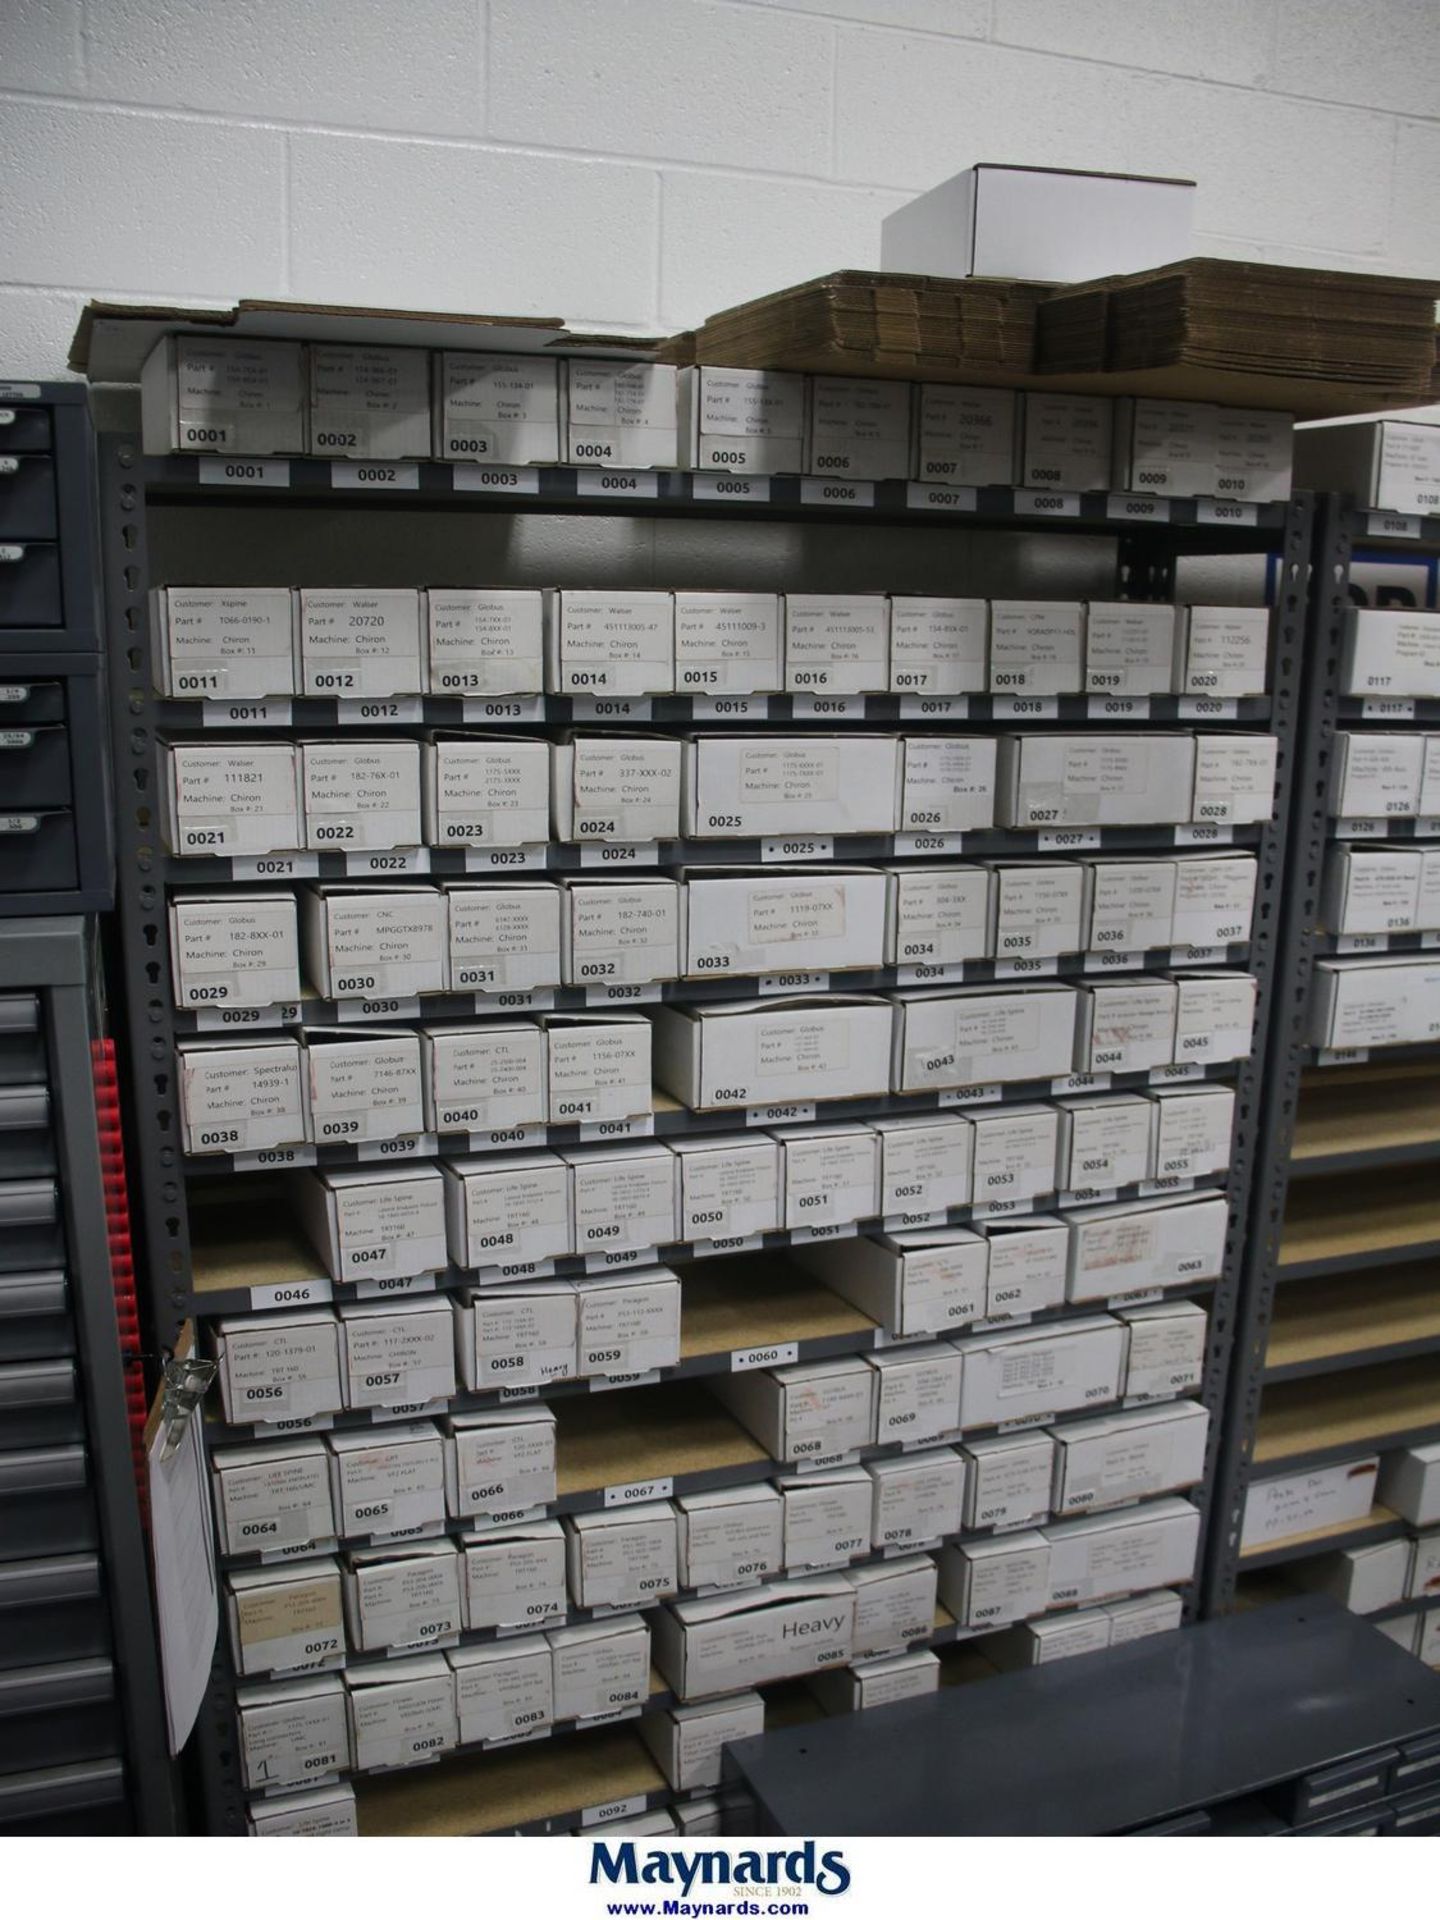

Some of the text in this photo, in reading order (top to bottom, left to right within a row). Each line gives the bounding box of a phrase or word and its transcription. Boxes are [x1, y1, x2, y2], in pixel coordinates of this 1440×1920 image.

[187, 429, 226, 442] 0001
[318, 433, 356, 446] 0002
[450, 440, 487, 452] 0003
[576, 445, 611, 457] 0004
[712, 452, 745, 464] 0005
[817, 456, 849, 468] 0006
[226, 465, 263, 478] 0001
[926, 462, 957, 474] 0007
[358, 469, 396, 481] 0002
[481, 473, 517, 485] 0003
[602, 478, 637, 489] 0004
[717, 482, 750, 494] 0005
[823, 487, 855, 499] 0006
[309, 617, 328, 625] Part
[349, 616, 384, 626] 20720
[222, 636, 249, 644] Chiron
[356, 635, 385, 643] Chiron
[481, 637, 510, 645] Chiron
[179, 676, 217, 689] 0011
[315, 675, 353, 687] 0012
[442, 675, 478, 686] 0013
[572, 674, 606, 684] 0014
[684, 671, 717, 682] 0015
[795, 673, 827, 684] 0016
[896, 675, 927, 685] 0017
[996, 675, 1024, 685] 0018
[1092, 675, 1119, 686] 0019
[1191, 676, 1217, 686] 0020
[230, 707, 267, 719] 0011
[361, 705, 398, 717] 0012
[485, 704, 521, 716] 0013
[596, 703, 630, 714] 0014
[716, 702, 747, 712] 0015
[183, 776, 200, 784] Part
[225, 774, 262, 783] 111821
[311, 774, 329, 782] Part
[230, 794, 261, 802] Chiron
[357, 789, 386, 797] Chiron
[1030, 810, 1058, 821] 0027
[1200, 806, 1227, 816] 0028
[709, 816, 742, 827] 0025
[910, 813, 940, 823] 0026
[316, 827, 353, 839] 0022
[447, 825, 483, 837] 0023
[580, 822, 615, 833] 0024
[187, 832, 225, 844] 0021
[602, 849, 635, 860] 0024
[783, 843, 815, 854] 0025
[370, 857, 406, 869] 0022
[491, 853, 525, 864] 0023
[257, 861, 293, 873] 0021
[185, 934, 203, 943] Part
[1004, 937, 1031, 947] 0035
[1098, 931, 1124, 941] 0036
[379, 942, 408, 950] Chiron
[904, 945, 933, 954] 0034
[233, 949, 263, 957] Chiron
[697, 957, 729, 968] 0033
[581, 964, 615, 975] 0032
[460, 971, 494, 983] 0031
[779, 975, 809, 986] 0033
[338, 978, 374, 990] 0030
[190, 987, 228, 1000] 0029
[608, 987, 640, 998] 0032
[499, 995, 532, 1006] 0031
[363, 1002, 398, 1014] 0030
[223, 1011, 260, 1022] 0029
[926, 1055, 955, 1070] 0043
[1096, 1053, 1122, 1064] 0044
[715, 1089, 746, 1099] 0042
[559, 1103, 592, 1114] 0041
[767, 1107, 797, 1118] 0042
[443, 1110, 478, 1123] 0040
[323, 1122, 358, 1134] 0039
[600, 1124, 630, 1134] 0041
[201, 1131, 238, 1144] 0038
[491, 1131, 524, 1143] 0040
[380, 1141, 415, 1153] 0039
[258, 1151, 294, 1163] 0038
[987, 1174, 1014, 1185] 0053
[895, 1185, 922, 1197] 0052
[800, 1195, 827, 1207] 0051
[692, 1211, 722, 1224] 0050
[587, 1226, 620, 1238] 0049
[481, 1234, 513, 1248] 0048
[352, 1250, 386, 1263] 0047
[606, 1251, 637, 1264] 0049
[502, 1263, 535, 1275] 0048
[379, 1278, 412, 1290] 0047
[274, 1289, 309, 1301] 0046
[948, 1304, 974, 1316] 0061
[491, 1357, 524, 1369] 0058
[589, 1351, 621, 1363] 0059
[748, 1351, 778, 1363] 0060
[366, 1373, 400, 1386] 0057
[247, 1387, 283, 1399] 0056
[793, 1441, 821, 1454] 0068
[472, 1484, 504, 1500] 0066
[624, 1486, 654, 1498] 0067
[355, 1504, 388, 1518] 0065
[242, 1523, 277, 1535] 0064
[835, 1539, 863, 1551] 0077
[738, 1562, 767, 1574] 0076
[640, 1579, 669, 1590] 0075
[527, 1603, 558, 1614] 0074
[420, 1622, 451, 1635] 0073
[782, 1615, 846, 1640] Heavy
[305, 1640, 338, 1654] 0072
[609, 1692, 639, 1702] 0084
[515, 1711, 544, 1725] 0083
[413, 1737, 444, 1751] 0082
[305, 1754, 336, 1769] 0081
[599, 1805, 627, 1817] 0092
